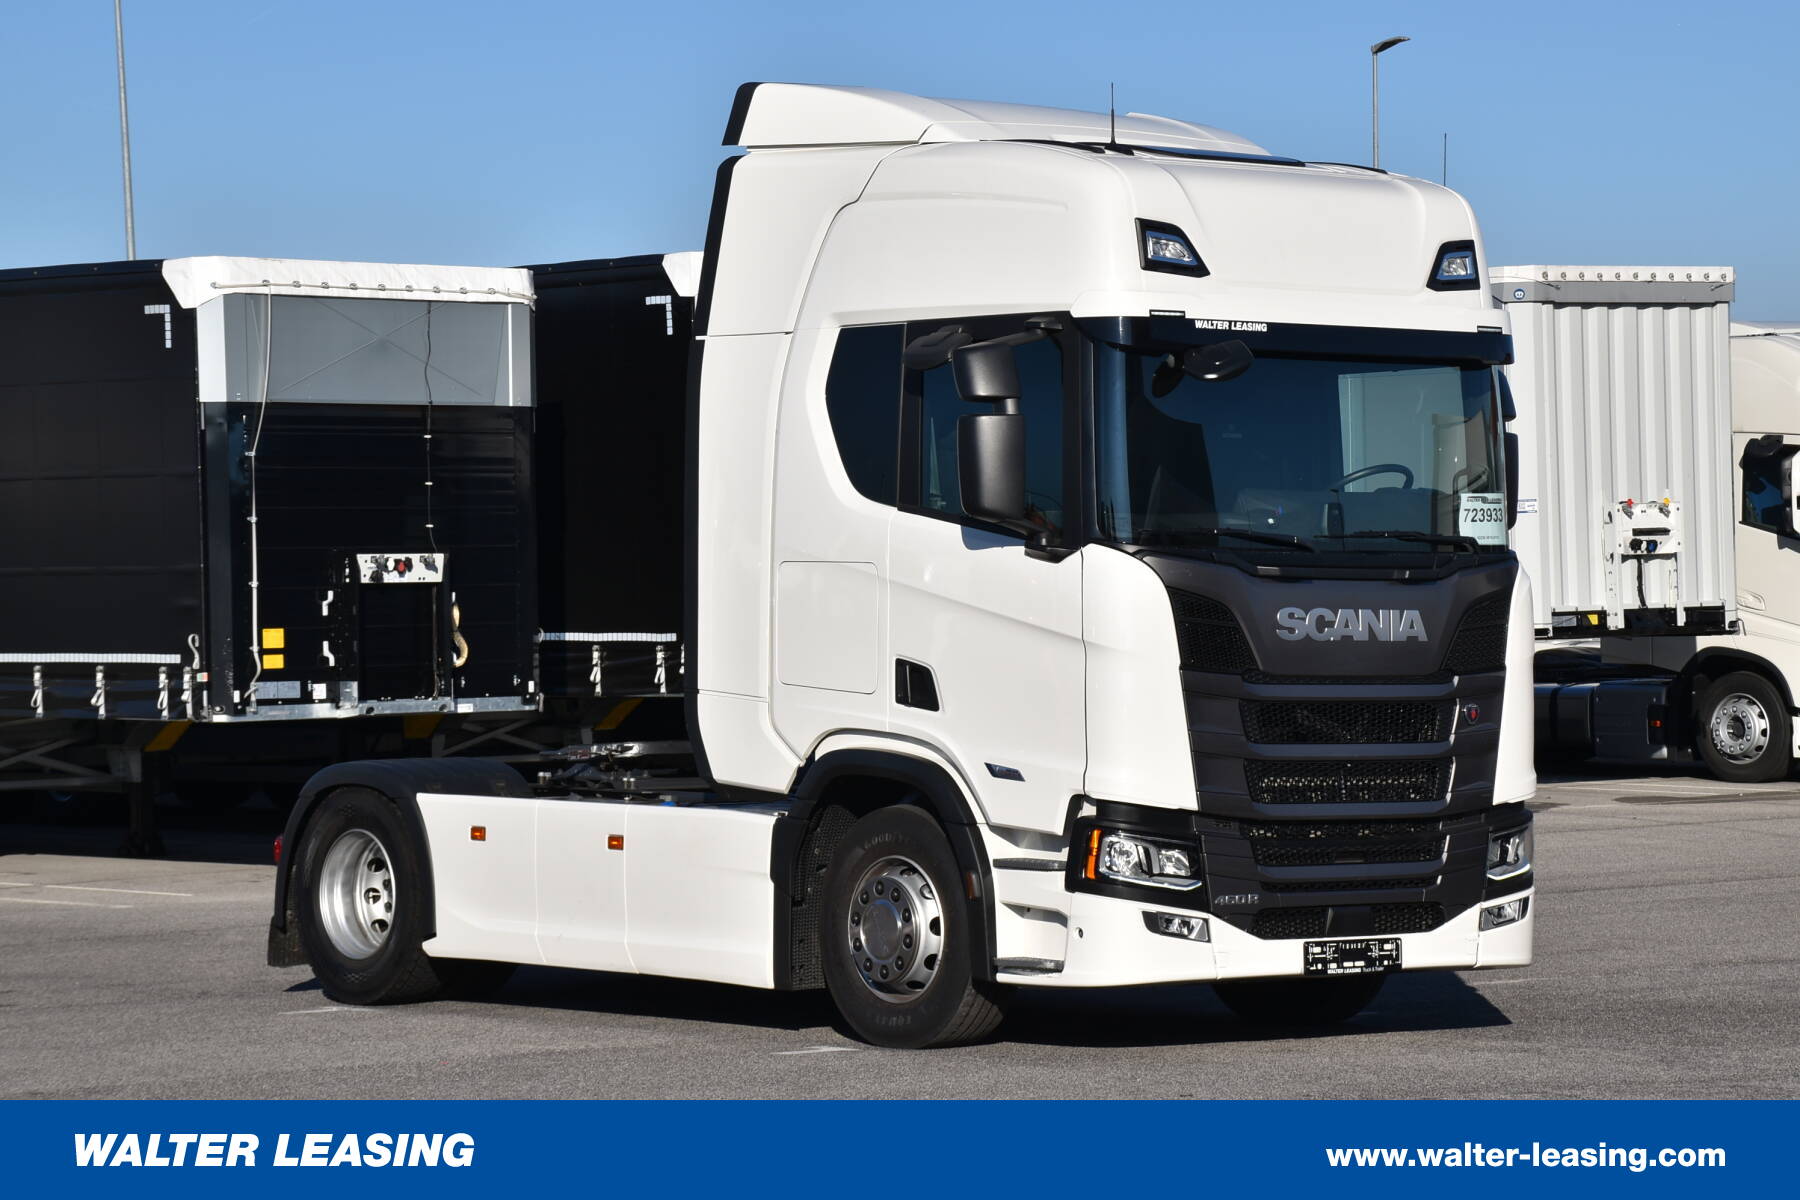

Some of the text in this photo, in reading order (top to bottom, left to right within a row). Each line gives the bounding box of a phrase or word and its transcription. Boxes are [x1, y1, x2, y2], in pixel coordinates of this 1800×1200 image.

[1195, 320, 1268, 332] WALTER LEASING
[1464, 508, 1503, 523] 723933
[1276, 607, 1429, 641] SCANIA
